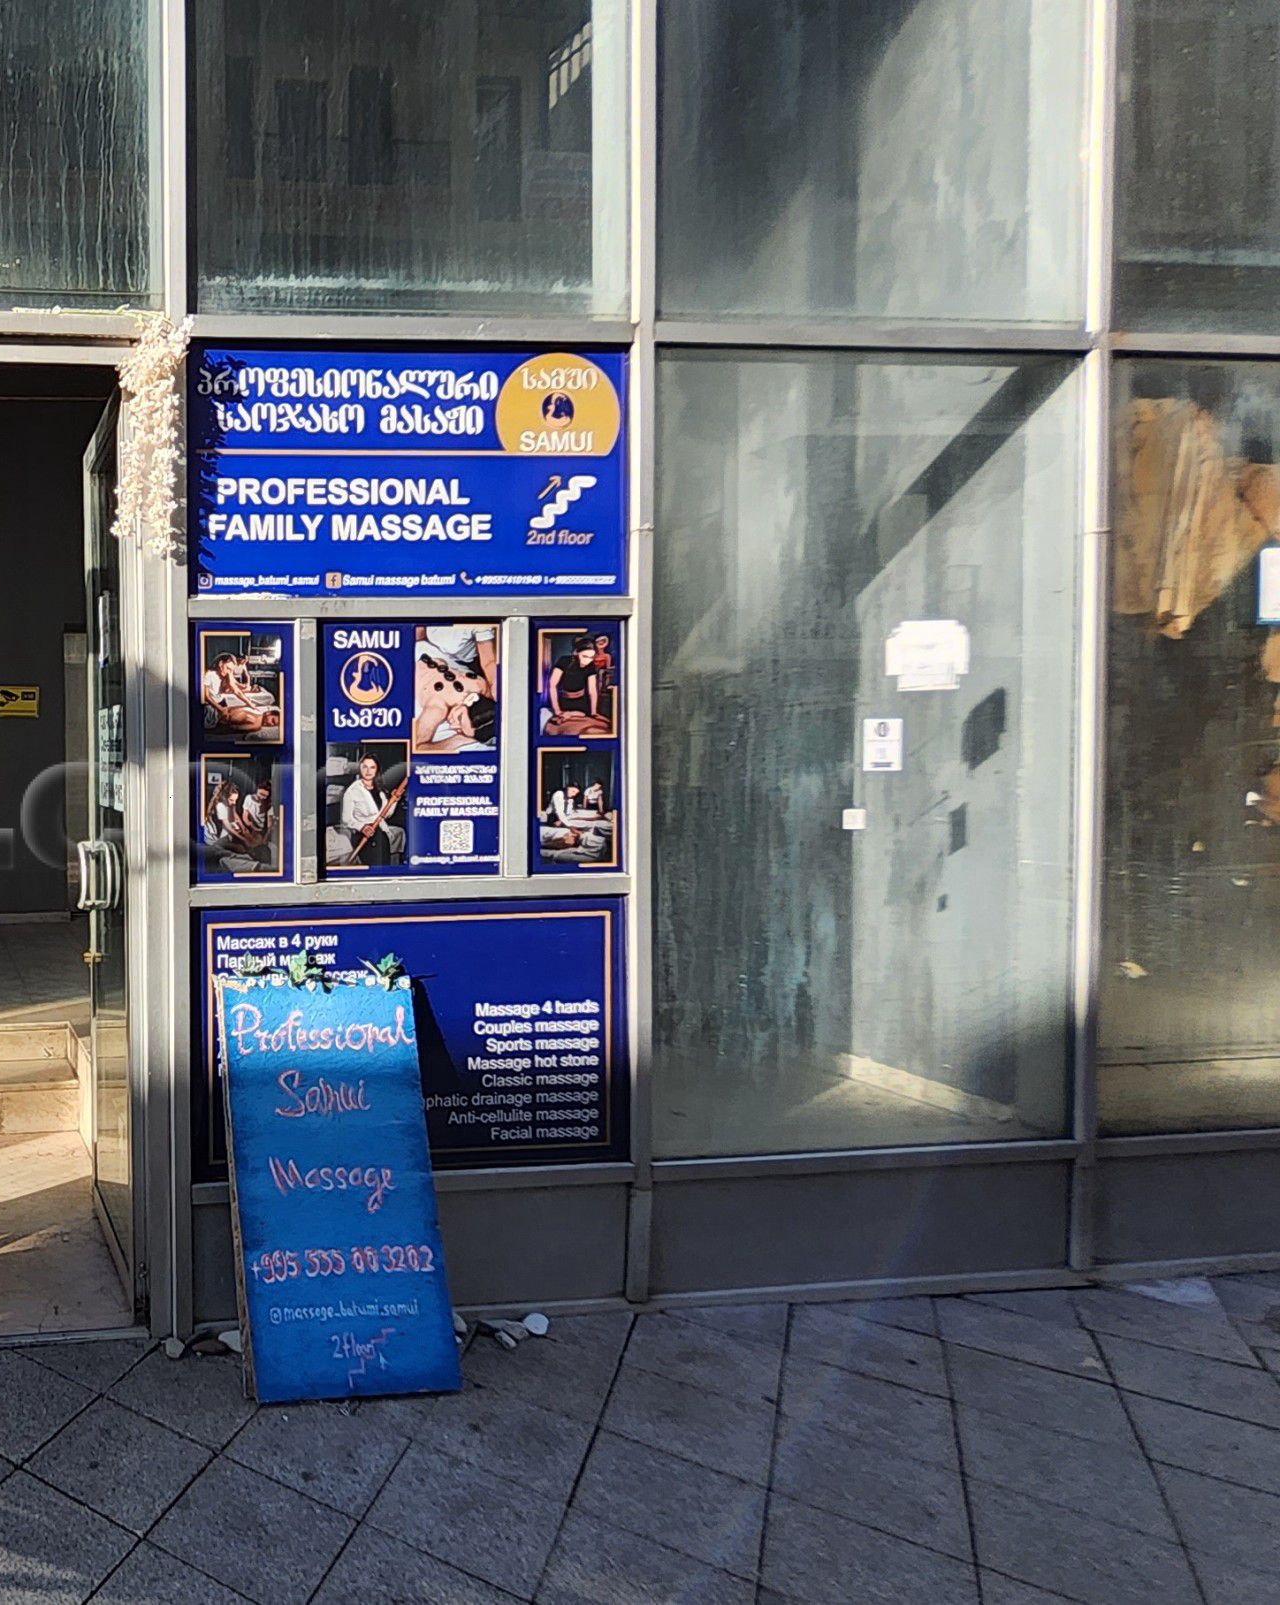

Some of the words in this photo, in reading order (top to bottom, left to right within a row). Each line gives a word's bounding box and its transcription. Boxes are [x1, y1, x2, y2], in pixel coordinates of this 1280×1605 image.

[197, 367, 499, 399] პროფესიონალური
[217, 402, 366, 434] საოჯახო
[380, 403, 485, 434] მასაჟი
[519, 431, 594, 453] SAMUI
[216, 477, 470, 506] PROFESSIONAL
[208, 513, 322, 542] FAMILY
[331, 513, 493, 542] MASSAGE
[526, 528, 555, 545] 2nd
[559, 529, 594, 545] floor
[375, 576, 420, 588] massage
[421, 574, 456, 586] batumi
[333, 630, 400, 649] SAMUI
[332, 707, 402, 728] სამუი
[416, 796, 493, 806] PROFESSIONAL
[413, 807, 449, 817] FAMILY
[450, 806, 499, 816] MASSAGE
[217, 935, 276, 950] Массаж
[279, 937, 288, 948] в
[291, 933, 302, 948] 4
[305, 934, 338, 950] руки
[475, 1002, 540, 1019] Massage
[542, 1001, 553, 1014] 4
[555, 999, 600, 1014] hands
[230, 1002, 416, 1056] Professional
[473, 1020, 532, 1036] Couples
[535, 1019, 600, 1034] massage
[486, 1038, 532, 1054] Sports
[535, 1037, 600, 1051] massage
[467, 1056, 532, 1072] Massage
[534, 1055, 558, 1068] hot
[560, 1054, 600, 1067] stone
[482, 1073, 533, 1087] Classic
[536, 1072, 600, 1087] massage
[471, 1092, 532, 1107] drainage
[536, 1090, 600, 1105] massage
[448, 1109, 533, 1125] Anti-cellulite
[536, 1107, 600, 1122] massage
[490, 1126, 532, 1140] Facial
[536, 1125, 600, 1139] massage
[269, 1155, 396, 1214] Massage
[251, 1249, 301, 1284] +995
[304, 1248, 346, 1278] 555
